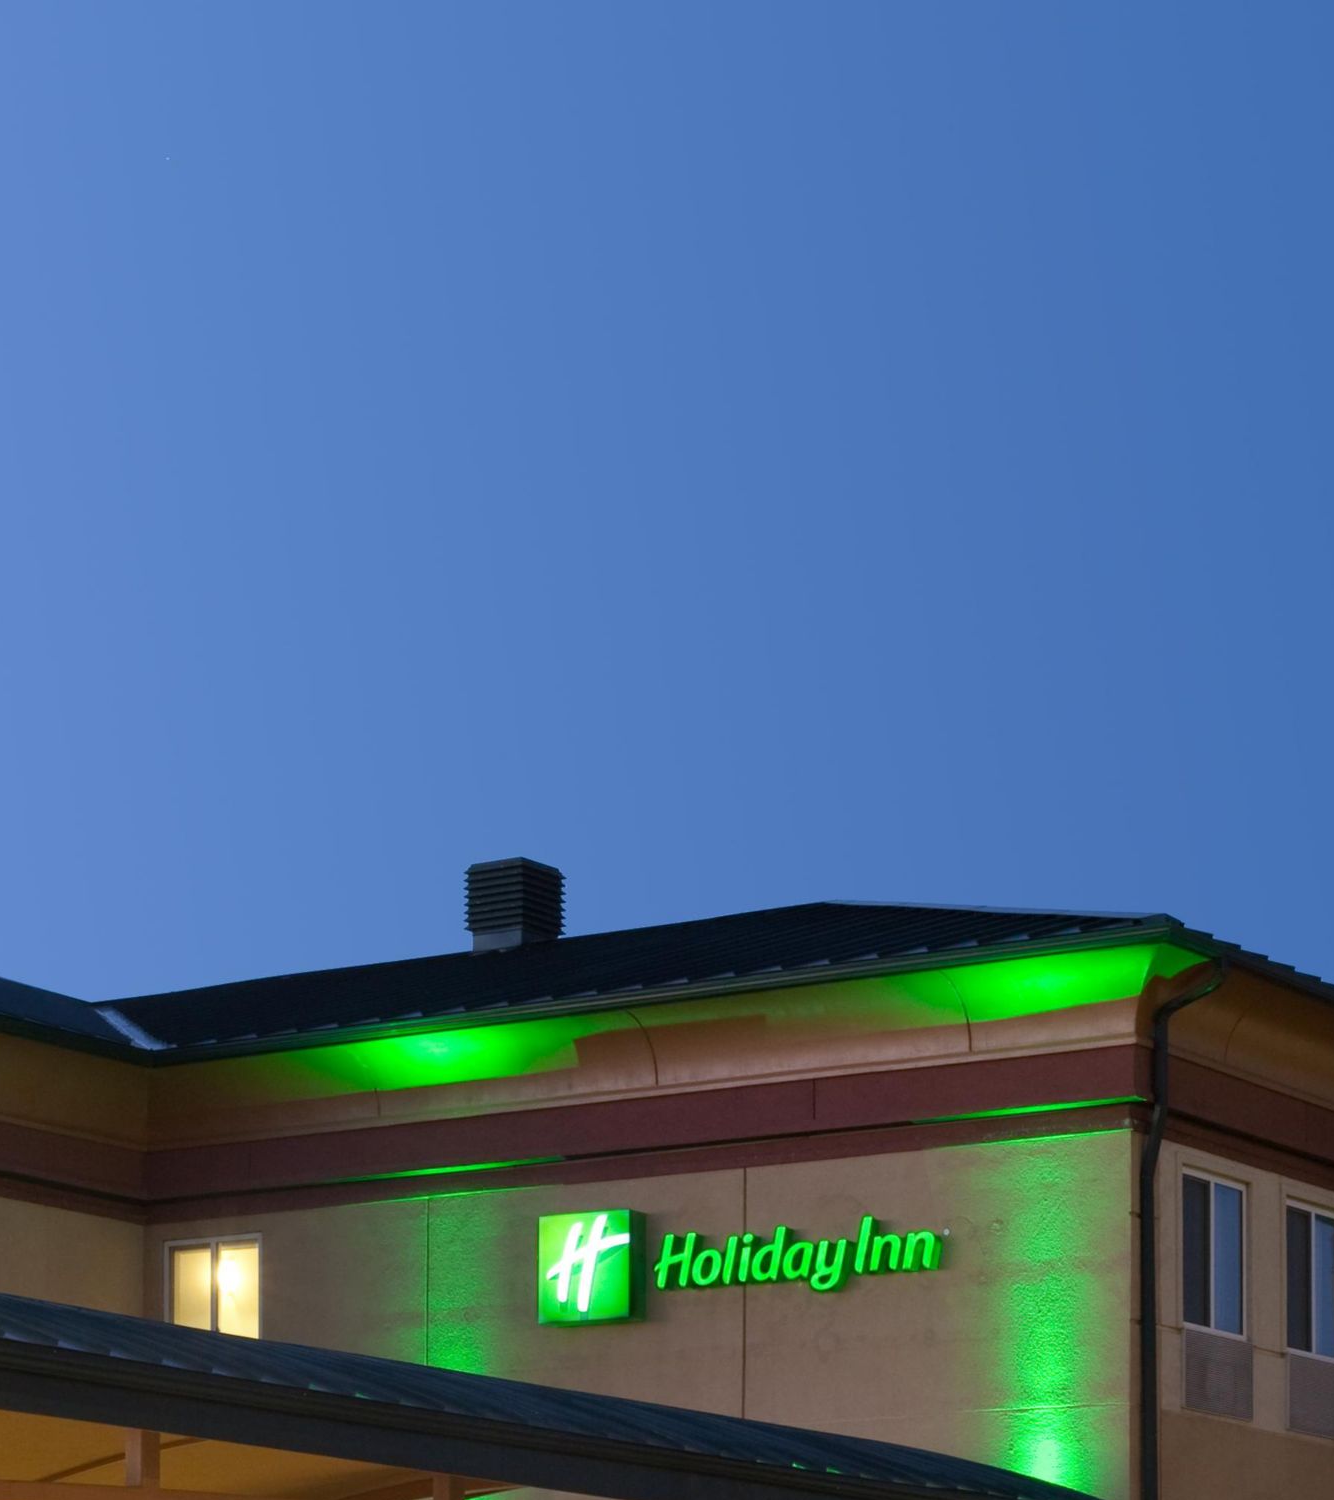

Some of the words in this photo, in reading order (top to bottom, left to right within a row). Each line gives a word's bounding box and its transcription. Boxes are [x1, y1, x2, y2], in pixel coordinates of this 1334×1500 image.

[547, 1214, 630, 1312] H
[654, 1225, 848, 1292] Holiday
[854, 1215, 940, 1274] Inn
